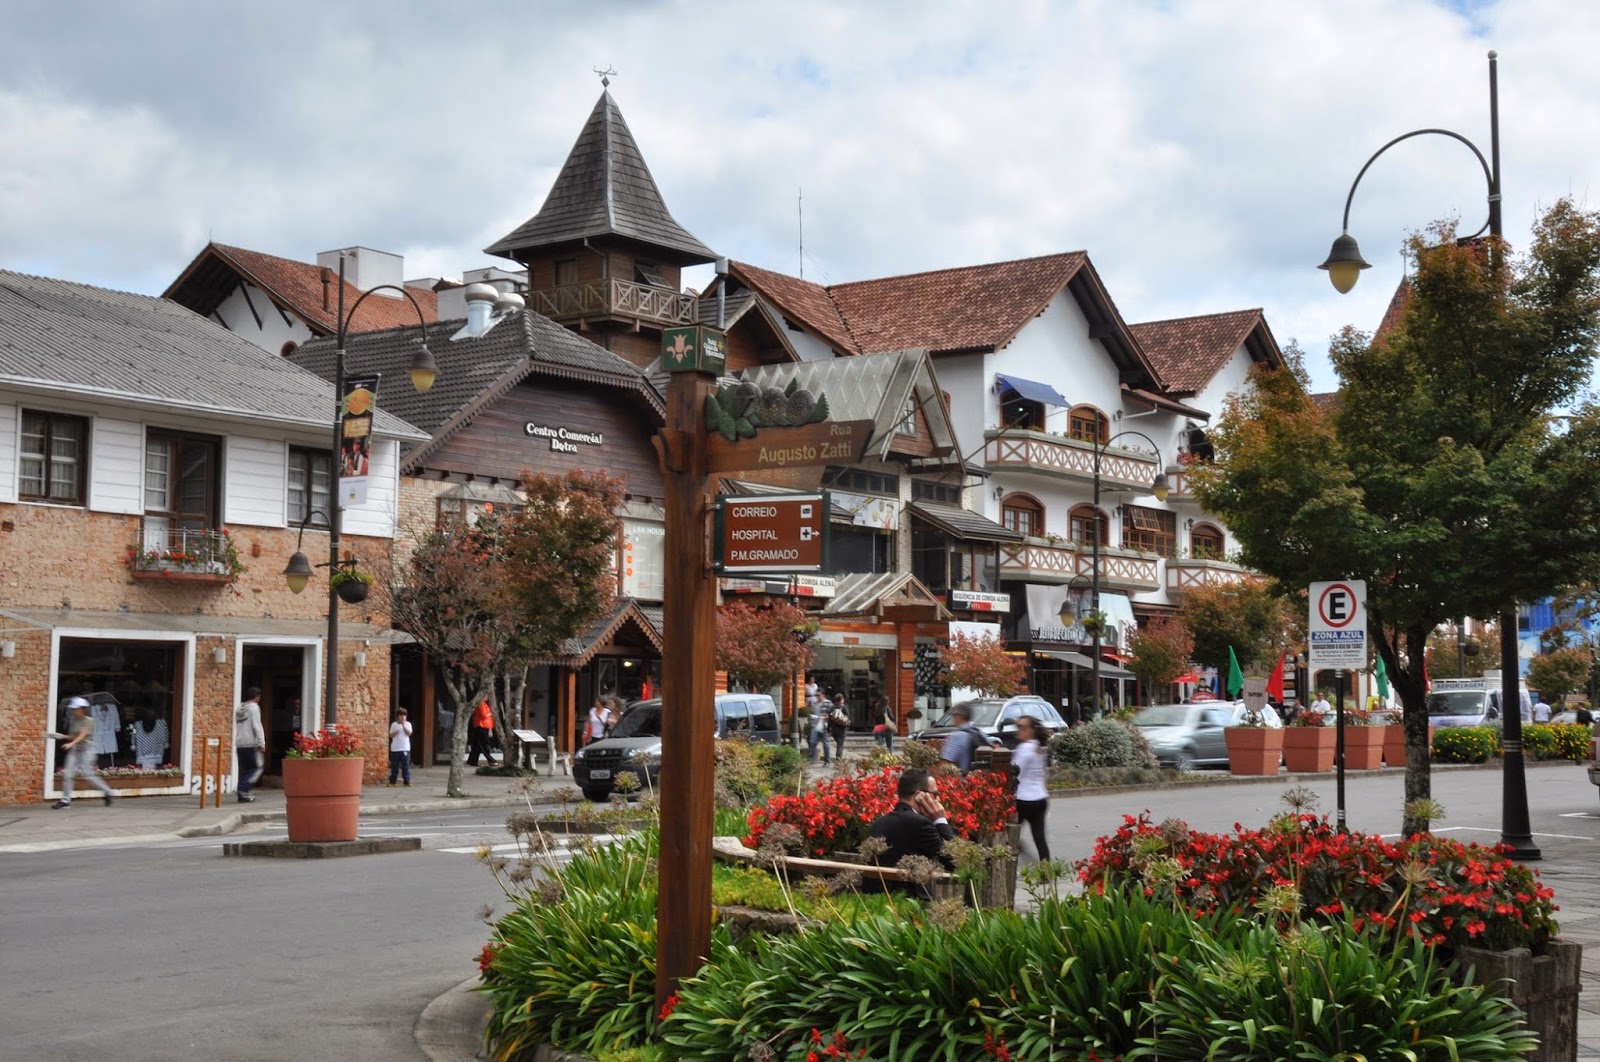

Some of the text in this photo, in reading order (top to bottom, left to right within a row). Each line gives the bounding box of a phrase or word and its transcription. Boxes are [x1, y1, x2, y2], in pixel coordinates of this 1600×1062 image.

[526, 422, 603, 444] Centro Comercial
[830, 424, 852, 436] Rua
[758, 442, 852, 465] Augusto Zatti
[732, 506, 777, 518] CORREIO
[731, 530, 778, 540] HOSPITAL
[731, 549, 799, 560] P.M.GRAMADO
[1329, 592, 1346, 620] E
[1314, 631, 1363, 639] ZONA AZUL
